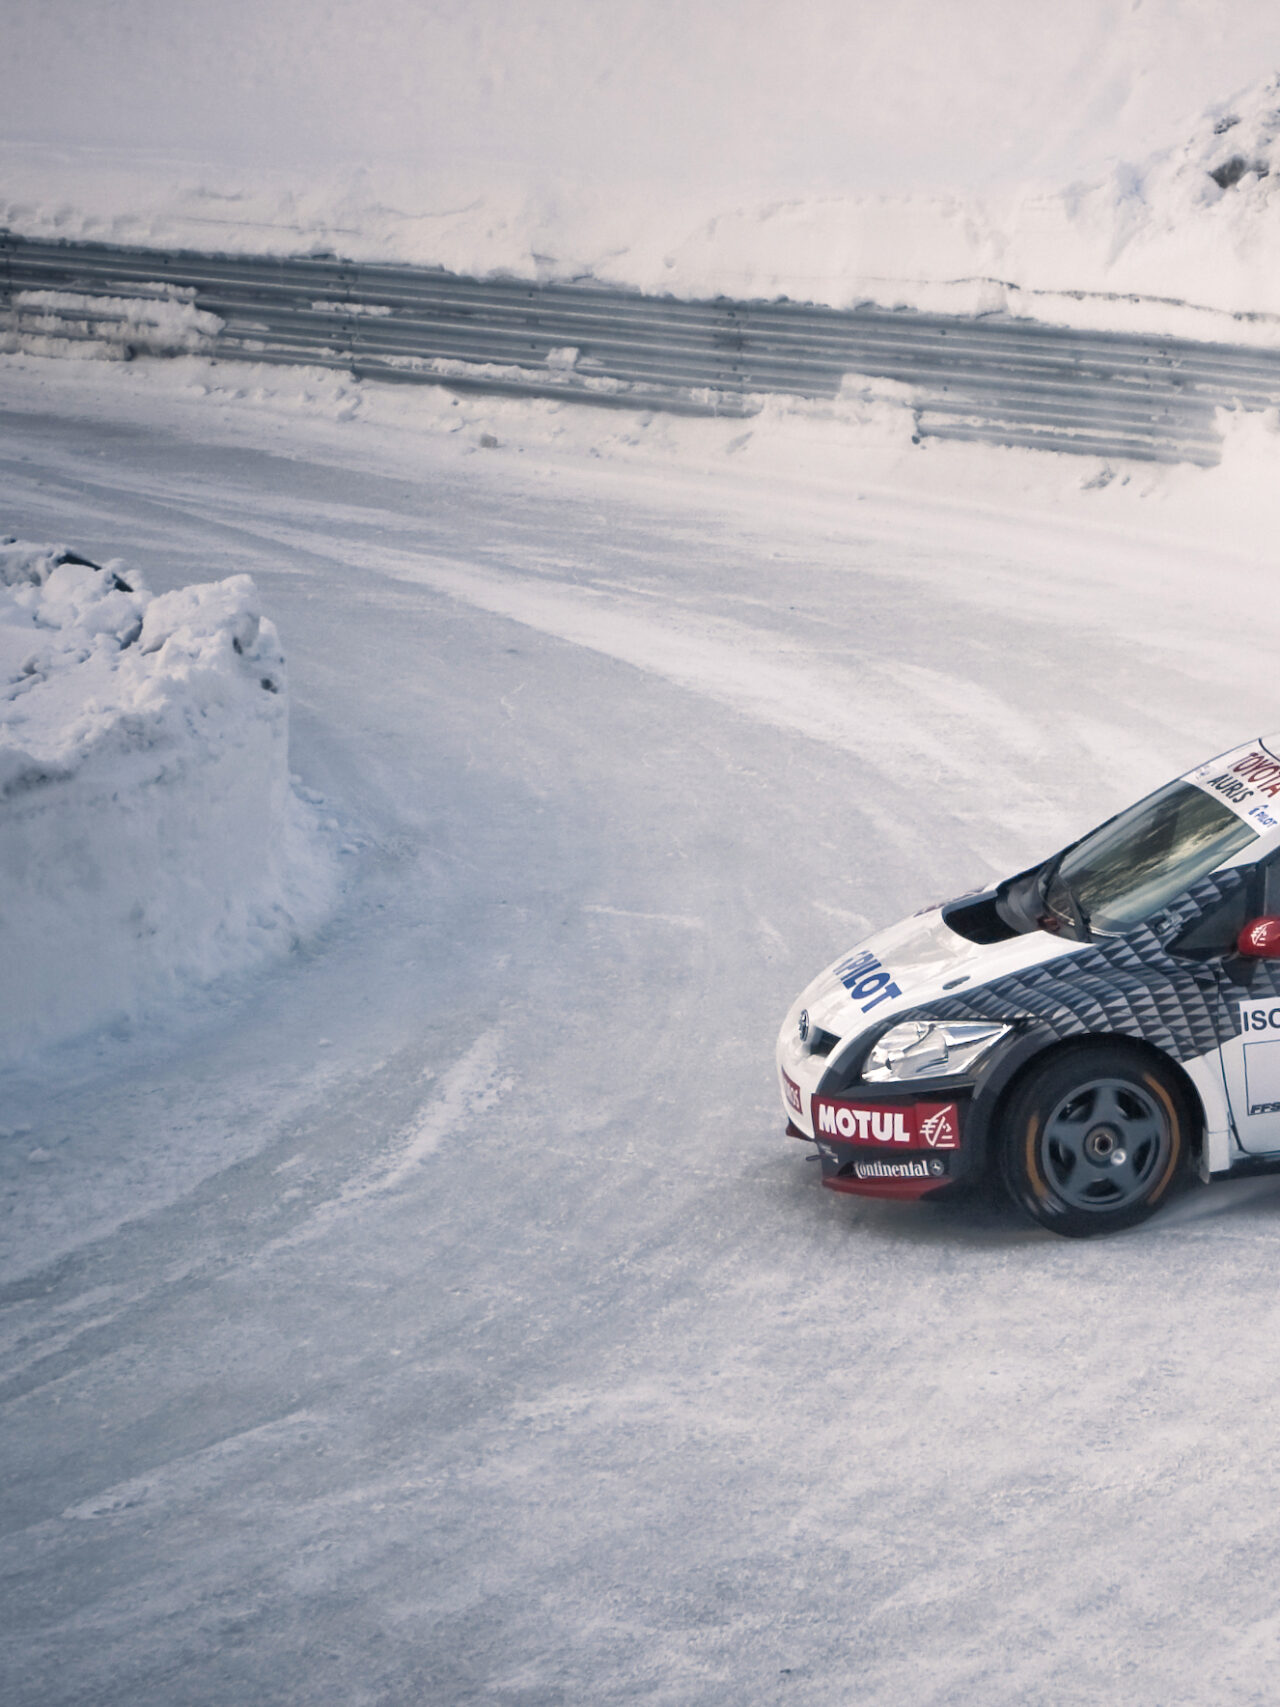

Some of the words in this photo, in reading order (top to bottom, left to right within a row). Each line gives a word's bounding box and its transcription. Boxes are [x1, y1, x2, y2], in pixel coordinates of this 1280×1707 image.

[1206, 773, 1254, 803] AURIS
[833, 951, 902, 1013] PILOT
[818, 1103, 910, 1142] MOTUL
[853, 1159, 930, 1180] Continental
